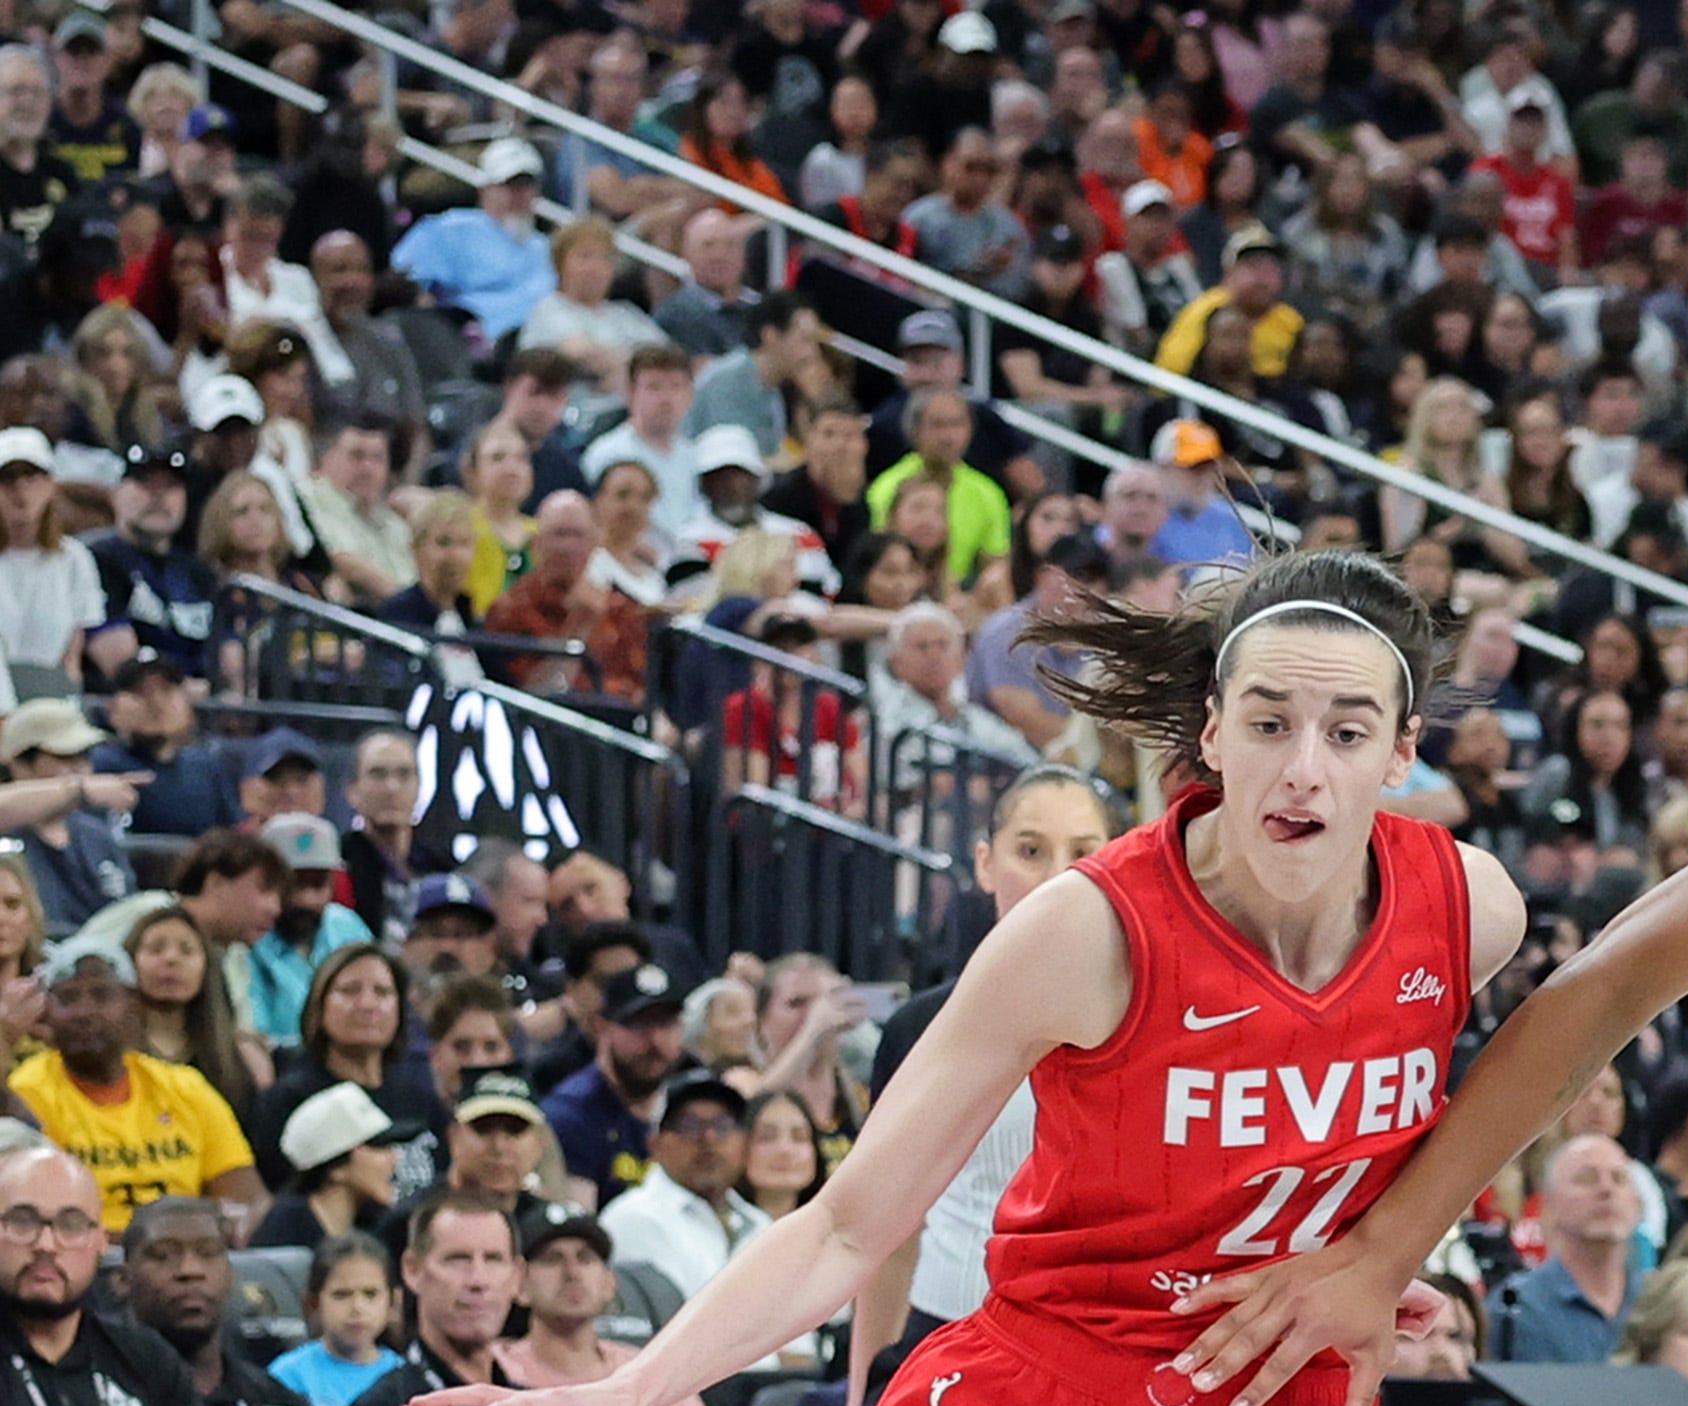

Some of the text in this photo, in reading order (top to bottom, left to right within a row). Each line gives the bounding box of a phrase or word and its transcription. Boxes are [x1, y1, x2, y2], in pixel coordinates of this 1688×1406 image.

[1396, 966, 1445, 1006] Lilly
[1163, 1047, 1437, 1147] FEVER
[1216, 1157, 1373, 1256] 22
